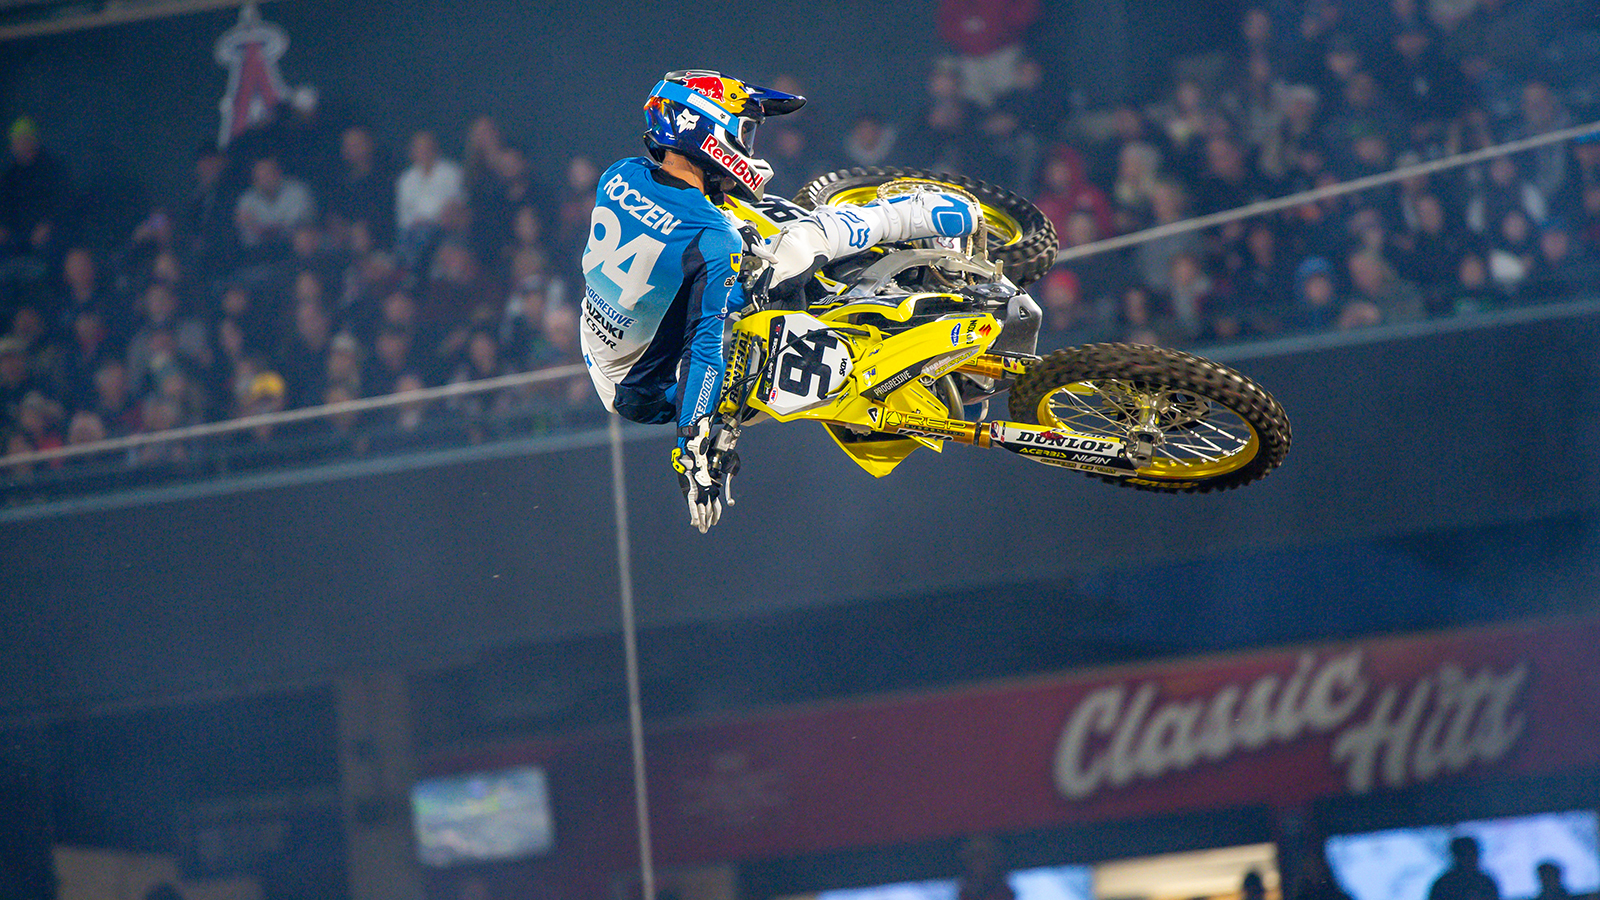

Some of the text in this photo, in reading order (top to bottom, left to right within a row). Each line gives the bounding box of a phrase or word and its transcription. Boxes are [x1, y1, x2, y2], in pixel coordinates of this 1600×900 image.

[603, 173, 682, 236] ROCZEN
[582, 206, 667, 312] 94
[778, 329, 839, 400] 94
[873, 370, 912, 397] PROGRESSIVE
[905, 414, 967, 429] REP
[1016, 431, 1114, 452] DUNLOP
[1054, 647, 1370, 799] Classic
